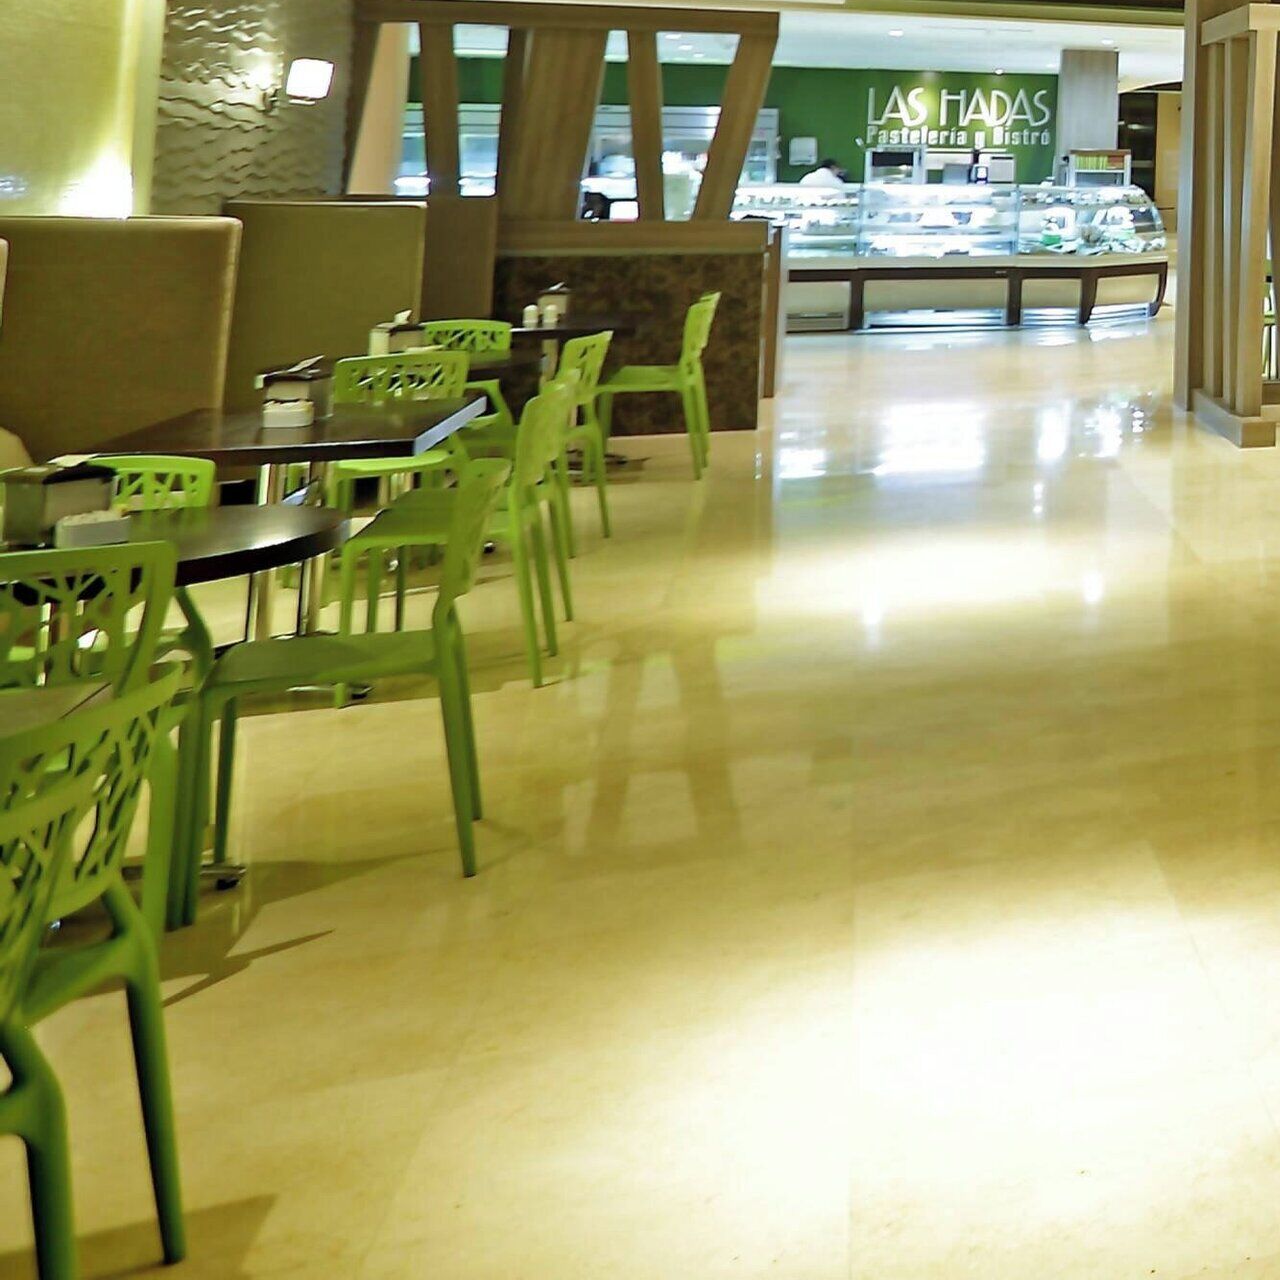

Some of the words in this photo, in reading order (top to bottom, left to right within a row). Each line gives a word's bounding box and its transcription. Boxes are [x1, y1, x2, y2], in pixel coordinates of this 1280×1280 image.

[867, 86, 928, 127] LAS
[940, 88, 1050, 127] HADAS
[866, 124, 968, 147] Pastelería
[992, 126, 1051, 146] Bistró
